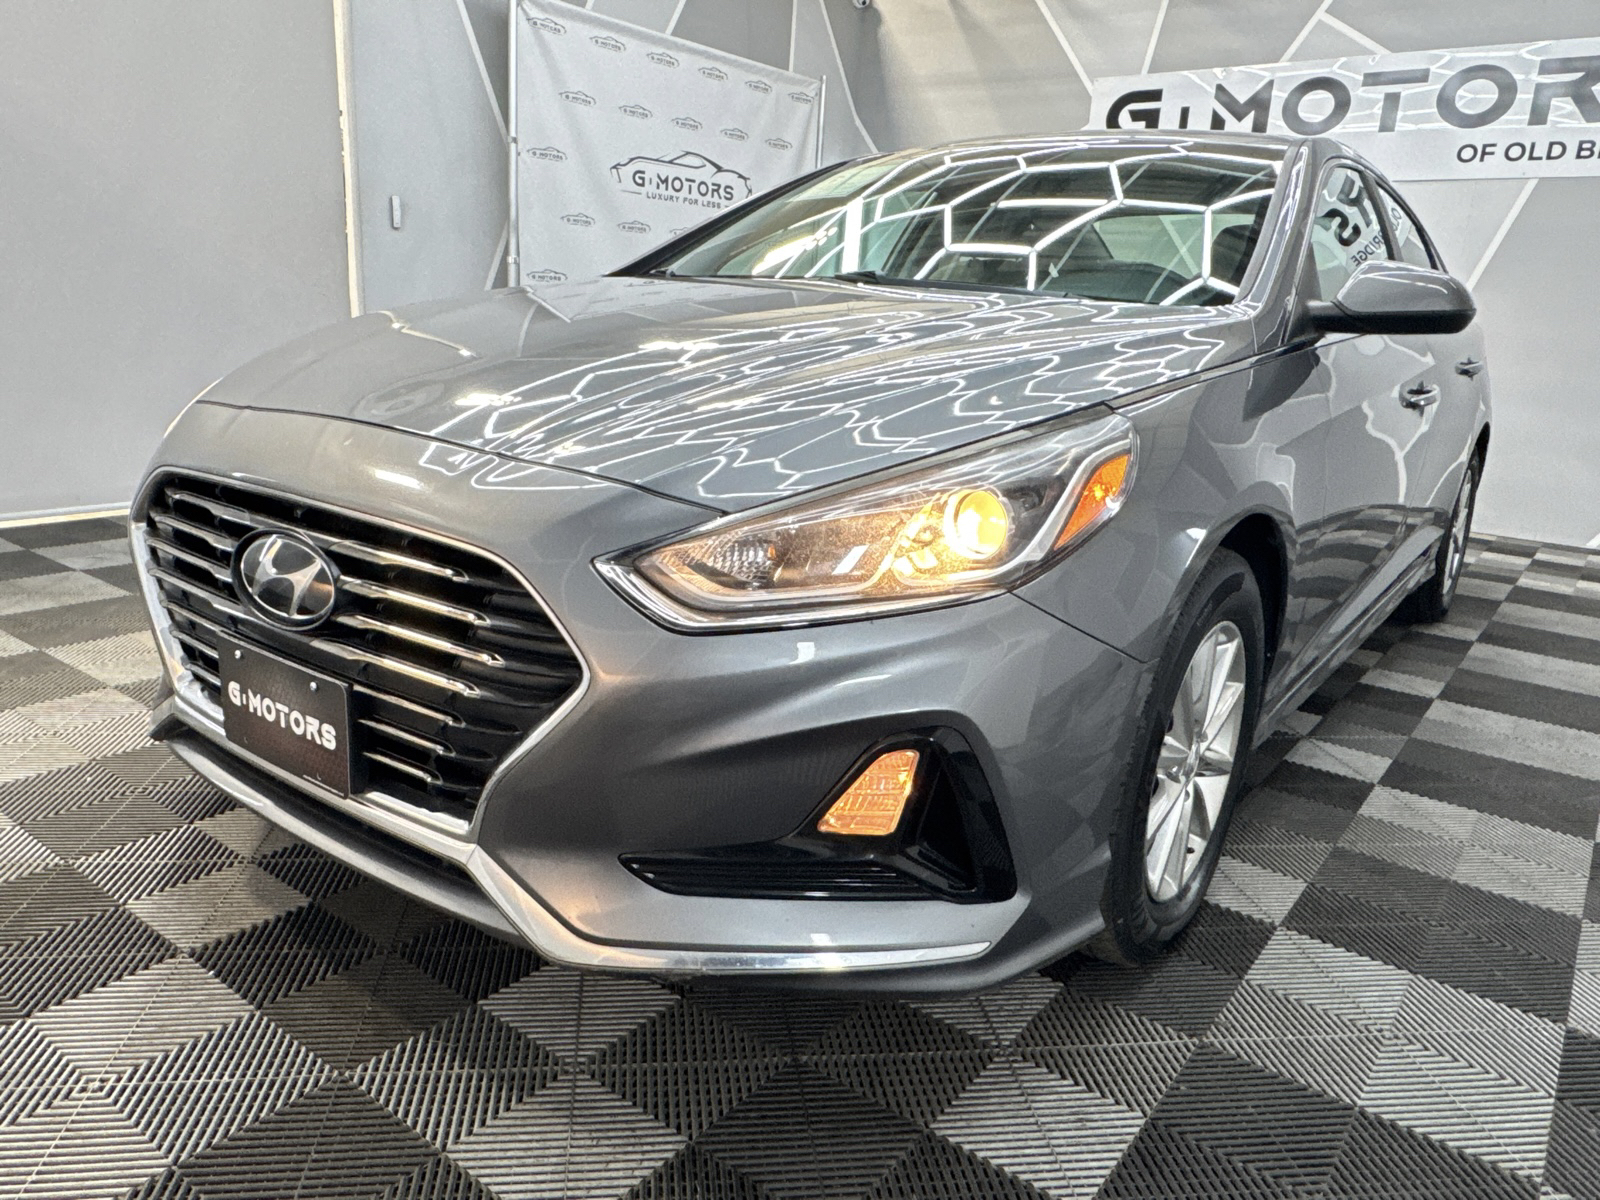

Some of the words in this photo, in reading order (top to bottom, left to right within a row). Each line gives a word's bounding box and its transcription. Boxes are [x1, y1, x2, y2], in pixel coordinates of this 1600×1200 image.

[1456, 143, 1498, 163] OF
[1504, 141, 1567, 162] OLD
[1575, 140, 1600, 160] B
[656, 173, 734, 201] MOTORS
[646, 191, 679, 203] LUXURY
[682, 197, 698, 206] FOR
[702, 200, 721, 209] LESS
[247, 688, 337, 751] MOTORS
